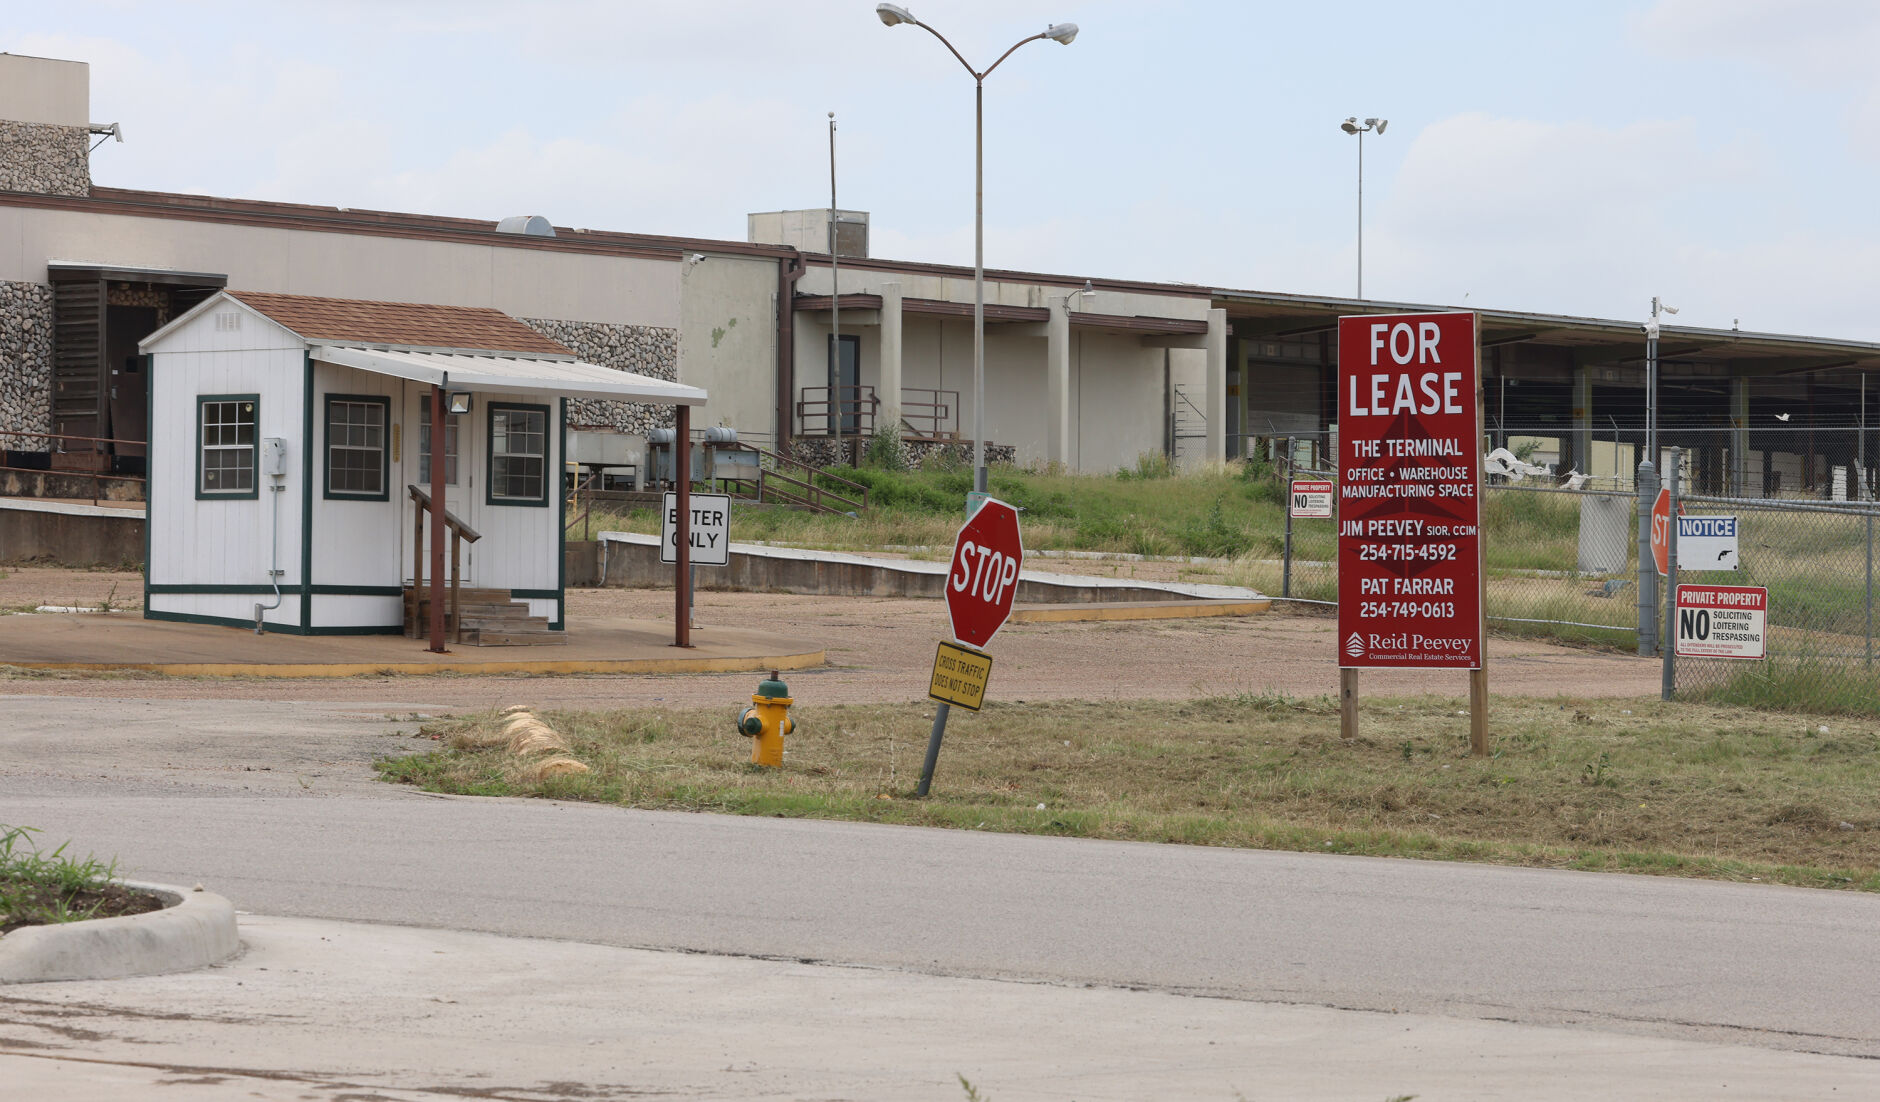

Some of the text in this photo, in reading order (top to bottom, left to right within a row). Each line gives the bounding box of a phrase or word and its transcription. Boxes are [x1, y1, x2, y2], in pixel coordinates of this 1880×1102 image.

[1370, 322, 1441, 366] FOR
[1350, 372, 1463, 416] LEASE
[1352, 438, 1463, 458] THE TERMINAL
[1347, 466, 1468, 481] OFFICE WAREHOUSE
[1342, 484, 1474, 498] MANUFACTURING SPACE
[1295, 494, 1307, 508] NO
[669, 508, 722, 526] ETER
[1340, 520, 1476, 536] JIM PEEVEY SIOR, CCIM
[1682, 520, 1733, 536] NOTICE
[1360, 544, 1456, 560] 254-715-4592
[953, 540, 1017, 606] STOP
[1361, 578, 1454, 594] PAT FARRAR
[1681, 591, 1762, 606] PRIVATE PROPERTY
[1360, 602, 1455, 618] 254-749-0613
[1713, 611, 1752, 620] SOLICITING
[1680, 609, 1710, 640] NO
[1713, 622, 1749, 631] LOITERING
[1368, 633, 1472, 654] Reid Peevey
[1712, 632, 1760, 642] TRESPASSING
[939, 655, 984, 680] CROSS TRAFFIC
[934, 673, 980, 697] DOES NOT STOP
